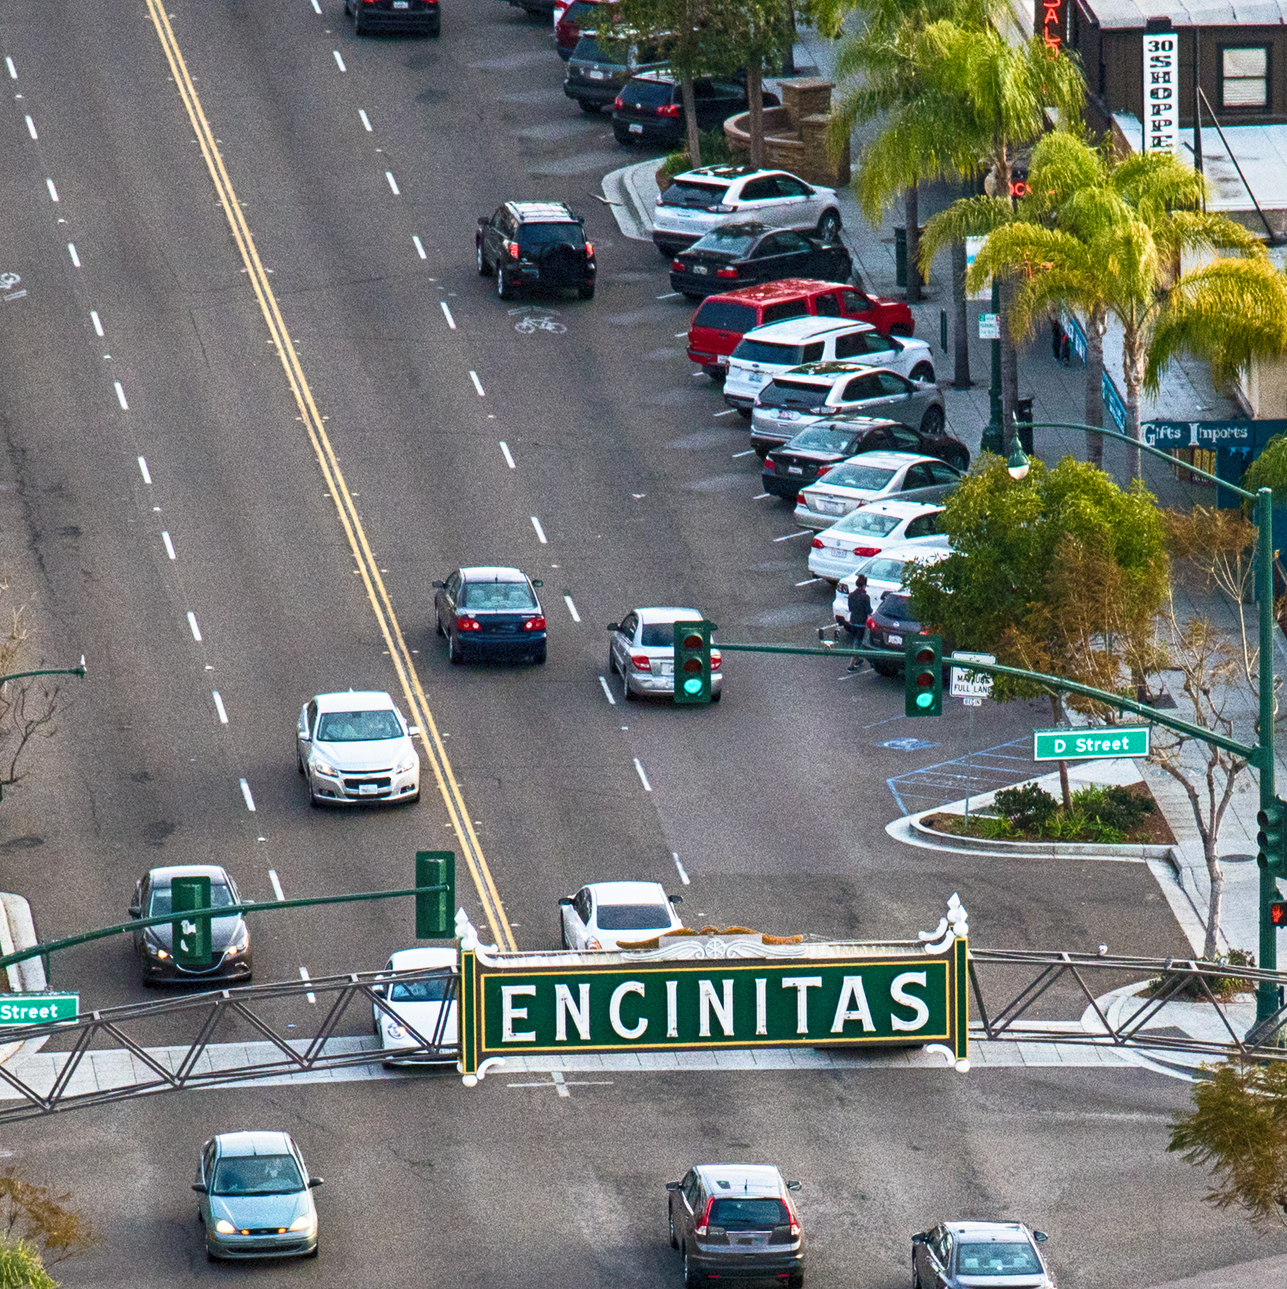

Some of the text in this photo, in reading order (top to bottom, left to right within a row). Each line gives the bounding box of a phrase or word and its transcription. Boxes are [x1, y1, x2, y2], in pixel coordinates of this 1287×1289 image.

[1147, 40, 1174, 52] 30
[1140, 423, 1248, 446] Gifts Imports
[954, 684, 970, 692] FULL
[1054, 736, 1129, 753] D Street
[0, 1003, 58, 1020] Street
[500, 971, 930, 1042] ENCINITAS
